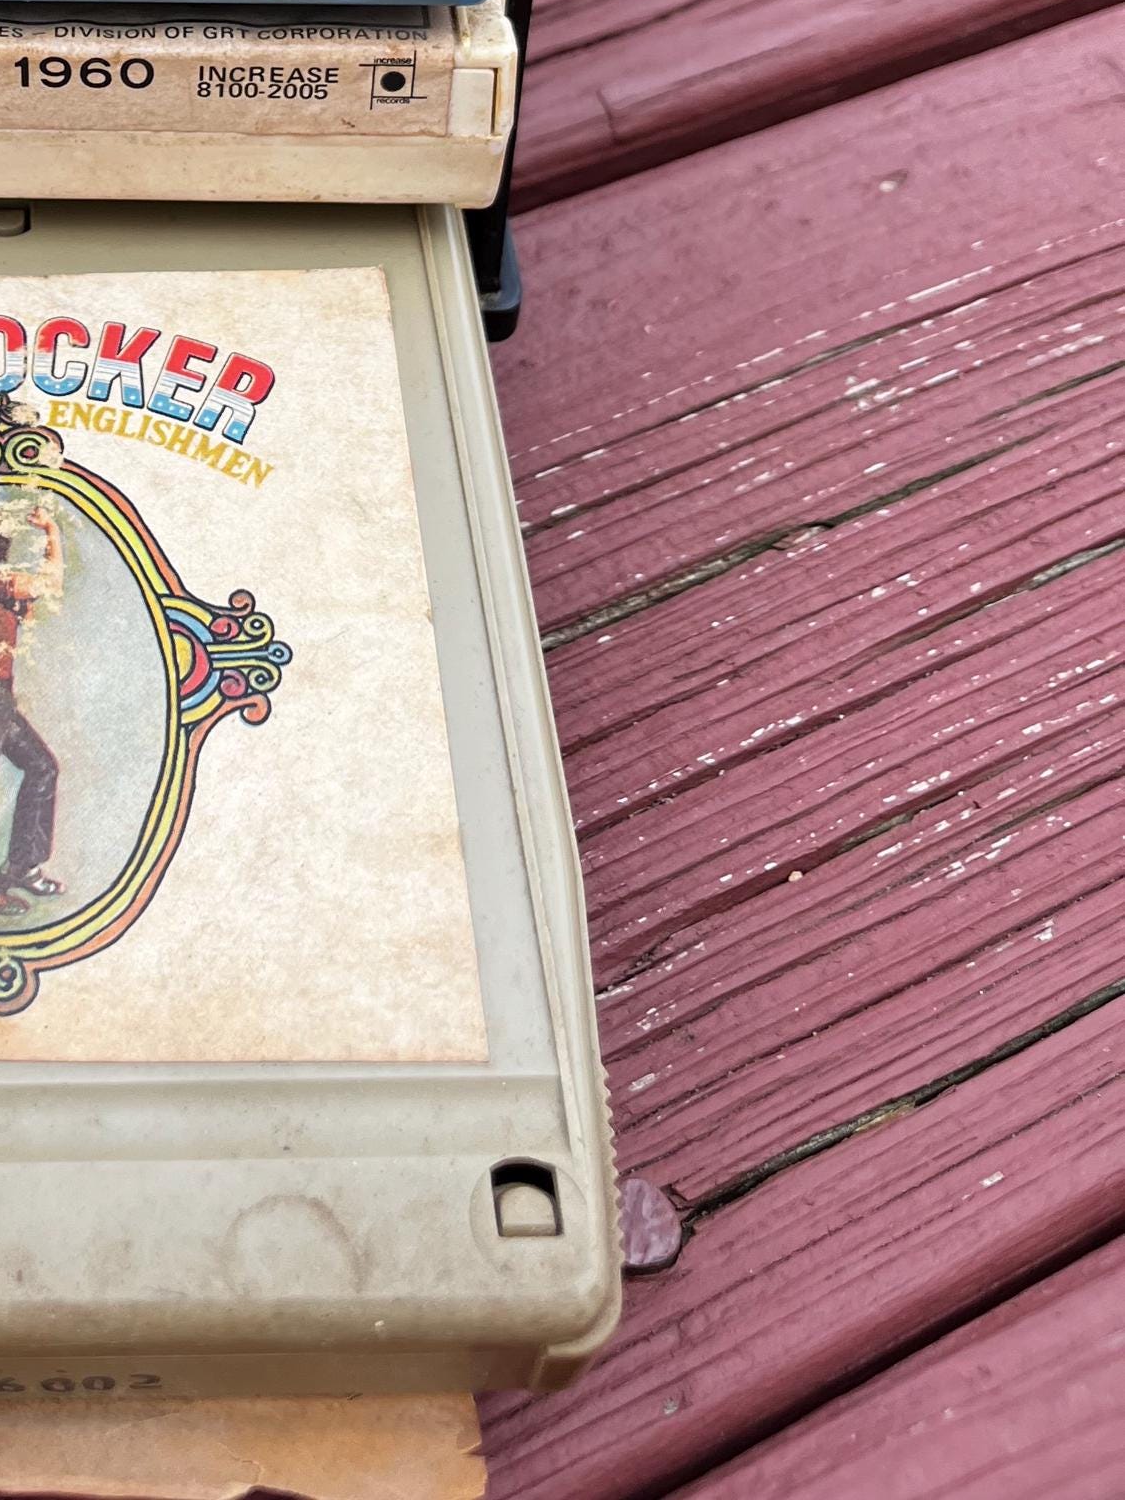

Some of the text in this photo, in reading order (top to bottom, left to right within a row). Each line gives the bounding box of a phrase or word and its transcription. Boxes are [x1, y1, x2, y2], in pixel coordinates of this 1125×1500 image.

[54, 25, 157, 40] DIVISION
[164, 26, 194, 40] OF
[202, 26, 250, 40] GRT
[258, 26, 428, 42] CORPORATION
[13, 55, 156, 90] 1960
[198, 65, 340, 85] INCREASE
[196, 81, 329, 101] 8100-2005
[45, 398, 276, 490] ENGLISHMEN
